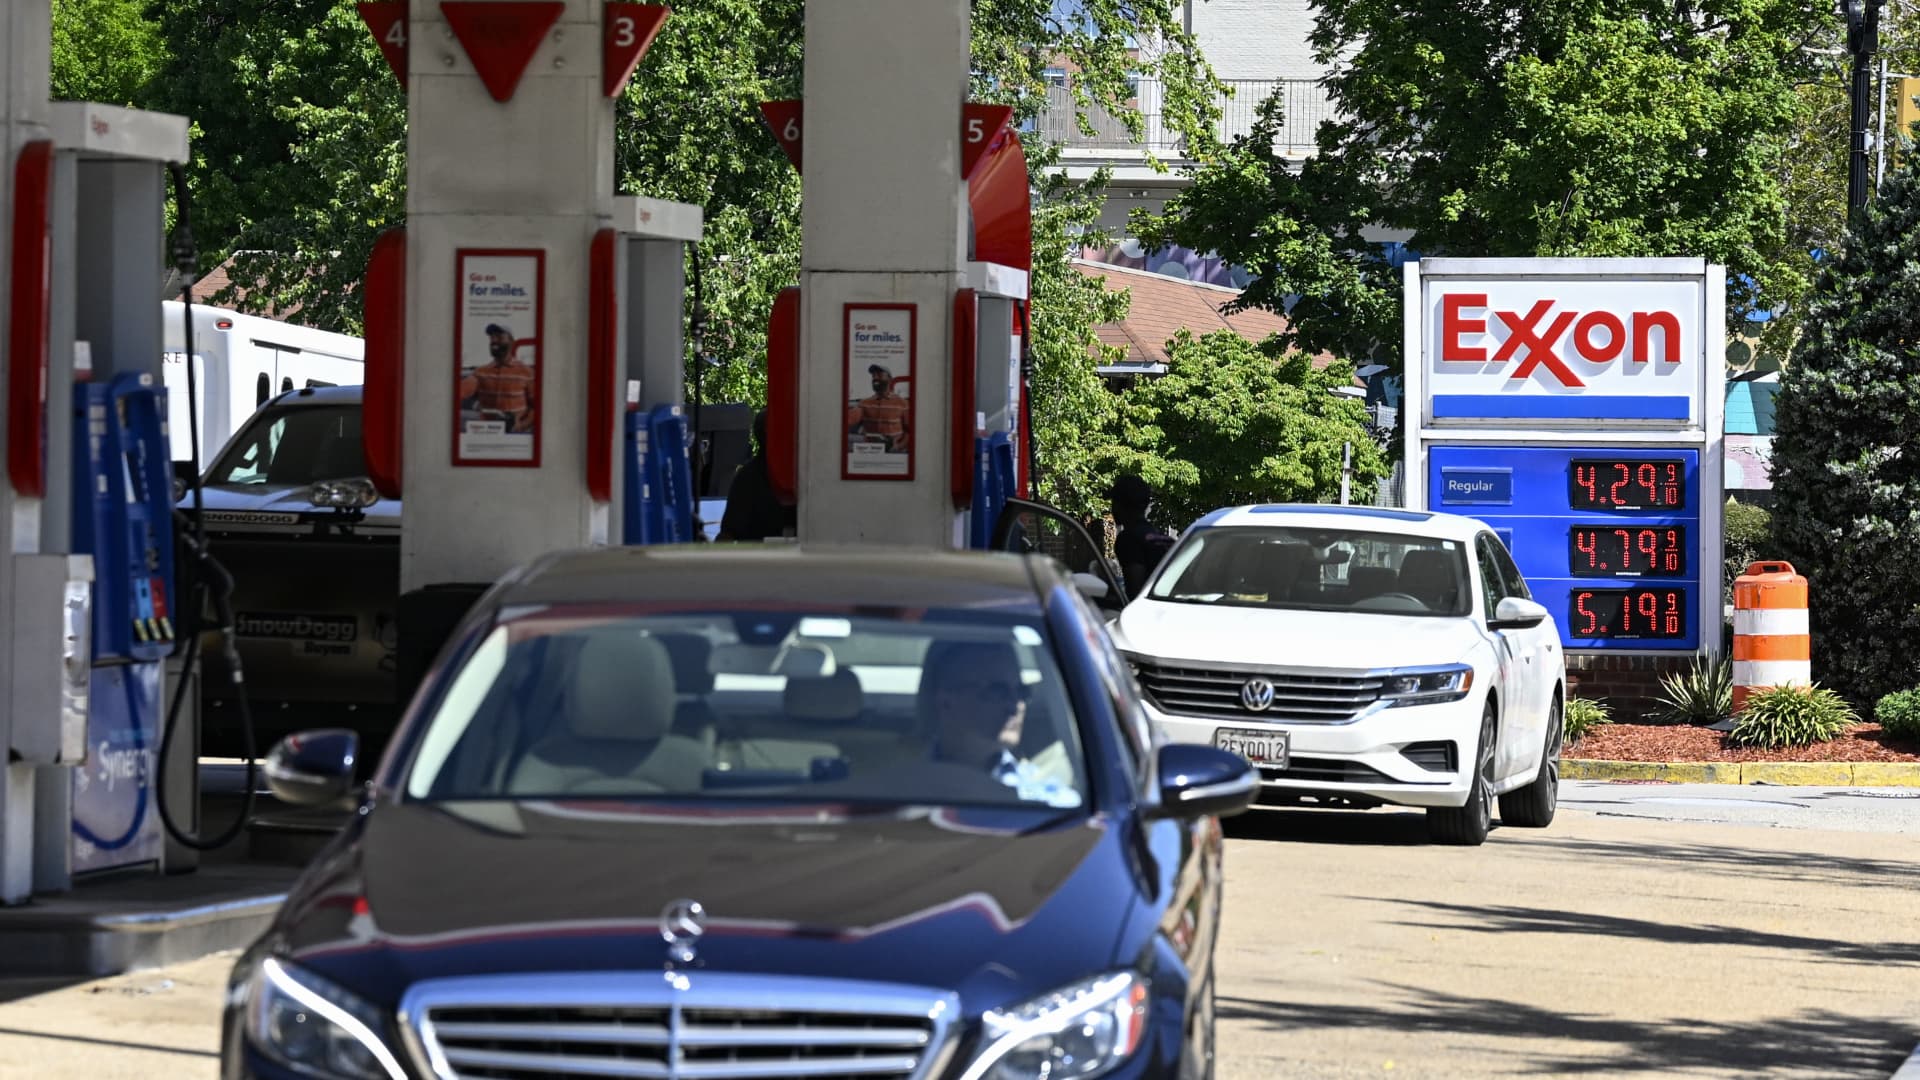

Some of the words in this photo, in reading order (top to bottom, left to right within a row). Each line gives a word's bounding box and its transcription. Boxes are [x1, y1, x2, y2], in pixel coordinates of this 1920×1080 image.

[384, 19, 406, 48] 4
[614, 17, 636, 47] 3
[782, 117, 800, 141] 6
[967, 119, 984, 143] 5
[469, 272, 482, 282] Go
[469, 283, 488, 296] for
[855, 323, 866, 331] Go
[855, 332, 870, 342] for
[1442, 293, 1681, 388] Exxon
[1448, 479, 1494, 494] Regular
[1577, 463, 1656, 505] 4.29
[1577, 529, 1657, 570] 4.79
[1577, 592, 1657, 634] 5.19
[237, 613, 355, 640] SnowDogg
